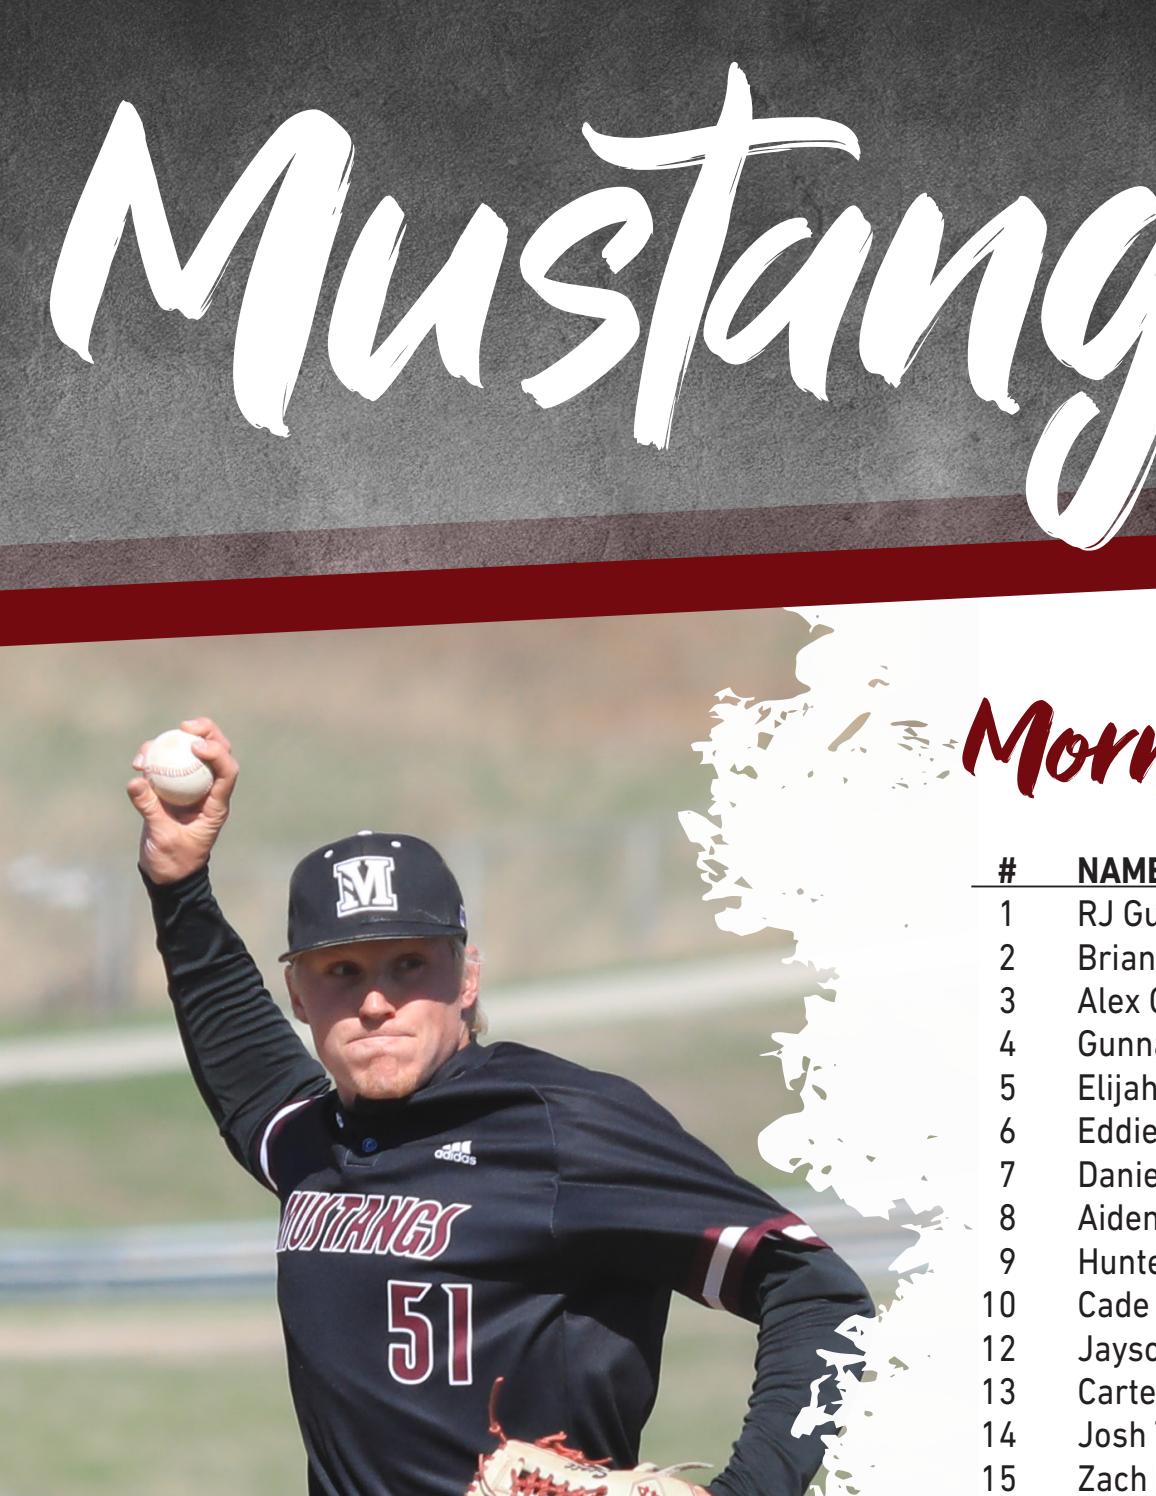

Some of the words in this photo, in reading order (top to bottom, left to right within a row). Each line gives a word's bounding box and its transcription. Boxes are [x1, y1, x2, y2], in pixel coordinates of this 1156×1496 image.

[998, 856, 1017, 884] #
[333, 855, 398, 918] M
[1001, 899, 1010, 927] 1
[1079, 899, 1113, 927] RJ
[1000, 986, 1015, 1014] 3
[1077, 986, 1141, 1014] Alex
[999, 1116, 1016, 1144] 6
[434, 1149, 476, 1165] adidas
[276, 1190, 471, 1260] MUSTANGS
[999, 1203, 1016, 1231] 8
[387, 1280, 473, 1386] 51
[983, 1334, 1015, 1362] 12
[983, 1420, 1017, 1448] 14
[1077, 1420, 1145, 1448] Josh
